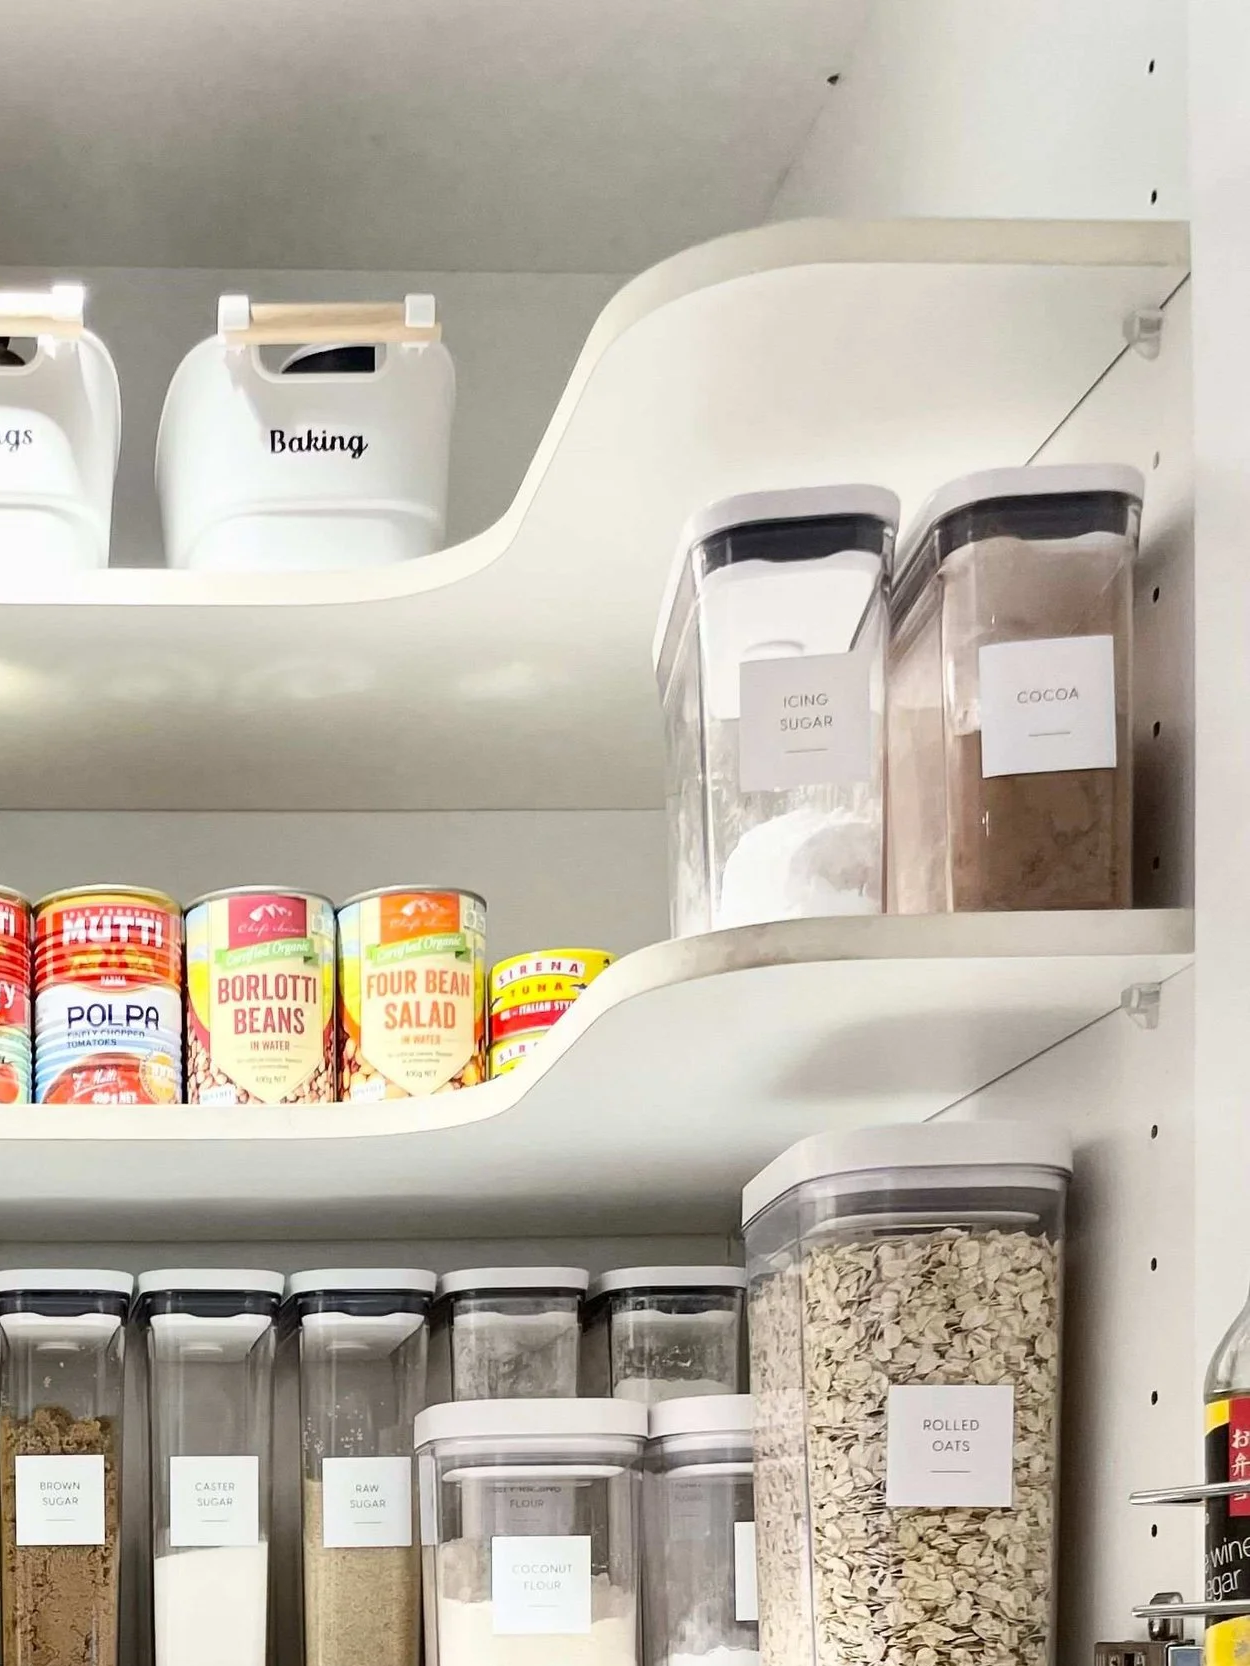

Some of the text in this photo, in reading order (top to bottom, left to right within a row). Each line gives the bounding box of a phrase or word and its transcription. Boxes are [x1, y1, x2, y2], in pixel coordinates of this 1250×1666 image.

[270, 429, 368, 459] Baking
[782, 692, 829, 709] ICING
[1016, 686, 1080, 705] COCOA
[779, 714, 834, 731] SUGAR
[62, 914, 164, 948] MUTTI
[423, 936, 461, 950] Organic
[225, 941, 310, 966] Certified Organic
[498, 961, 579, 985] SIRENA
[217, 974, 317, 1005] BORLOTTI
[366, 969, 470, 999] FOUR BEAN
[510, 982, 563, 997] TUNA
[66, 1003, 160, 1031] POLPA
[233, 1007, 305, 1035] BEANS
[384, 1002, 456, 1030] SALAD
[66, 1039, 117, 1049] TOMATOES
[250, 1040, 290, 1051] IN WATER
[401, 1034, 441, 1045] IN WATER
[923, 1419, 980, 1431] ROLLED
[932, 1440, 971, 1452] OATS
[39, 1482, 81, 1491] BROWN
[194, 1482, 235, 1492] CASTER
[355, 1484, 380, 1493] RAW
[42, 1497, 79, 1506] SUGAR
[197, 1497, 233, 1507] SUGAR
[349, 1499, 387, 1509] SUGAR
[510, 1500, 544, 1509] FLOUR
[512, 1563, 572, 1574] COCONUT
[523, 1581, 562, 1590] FLOUR
